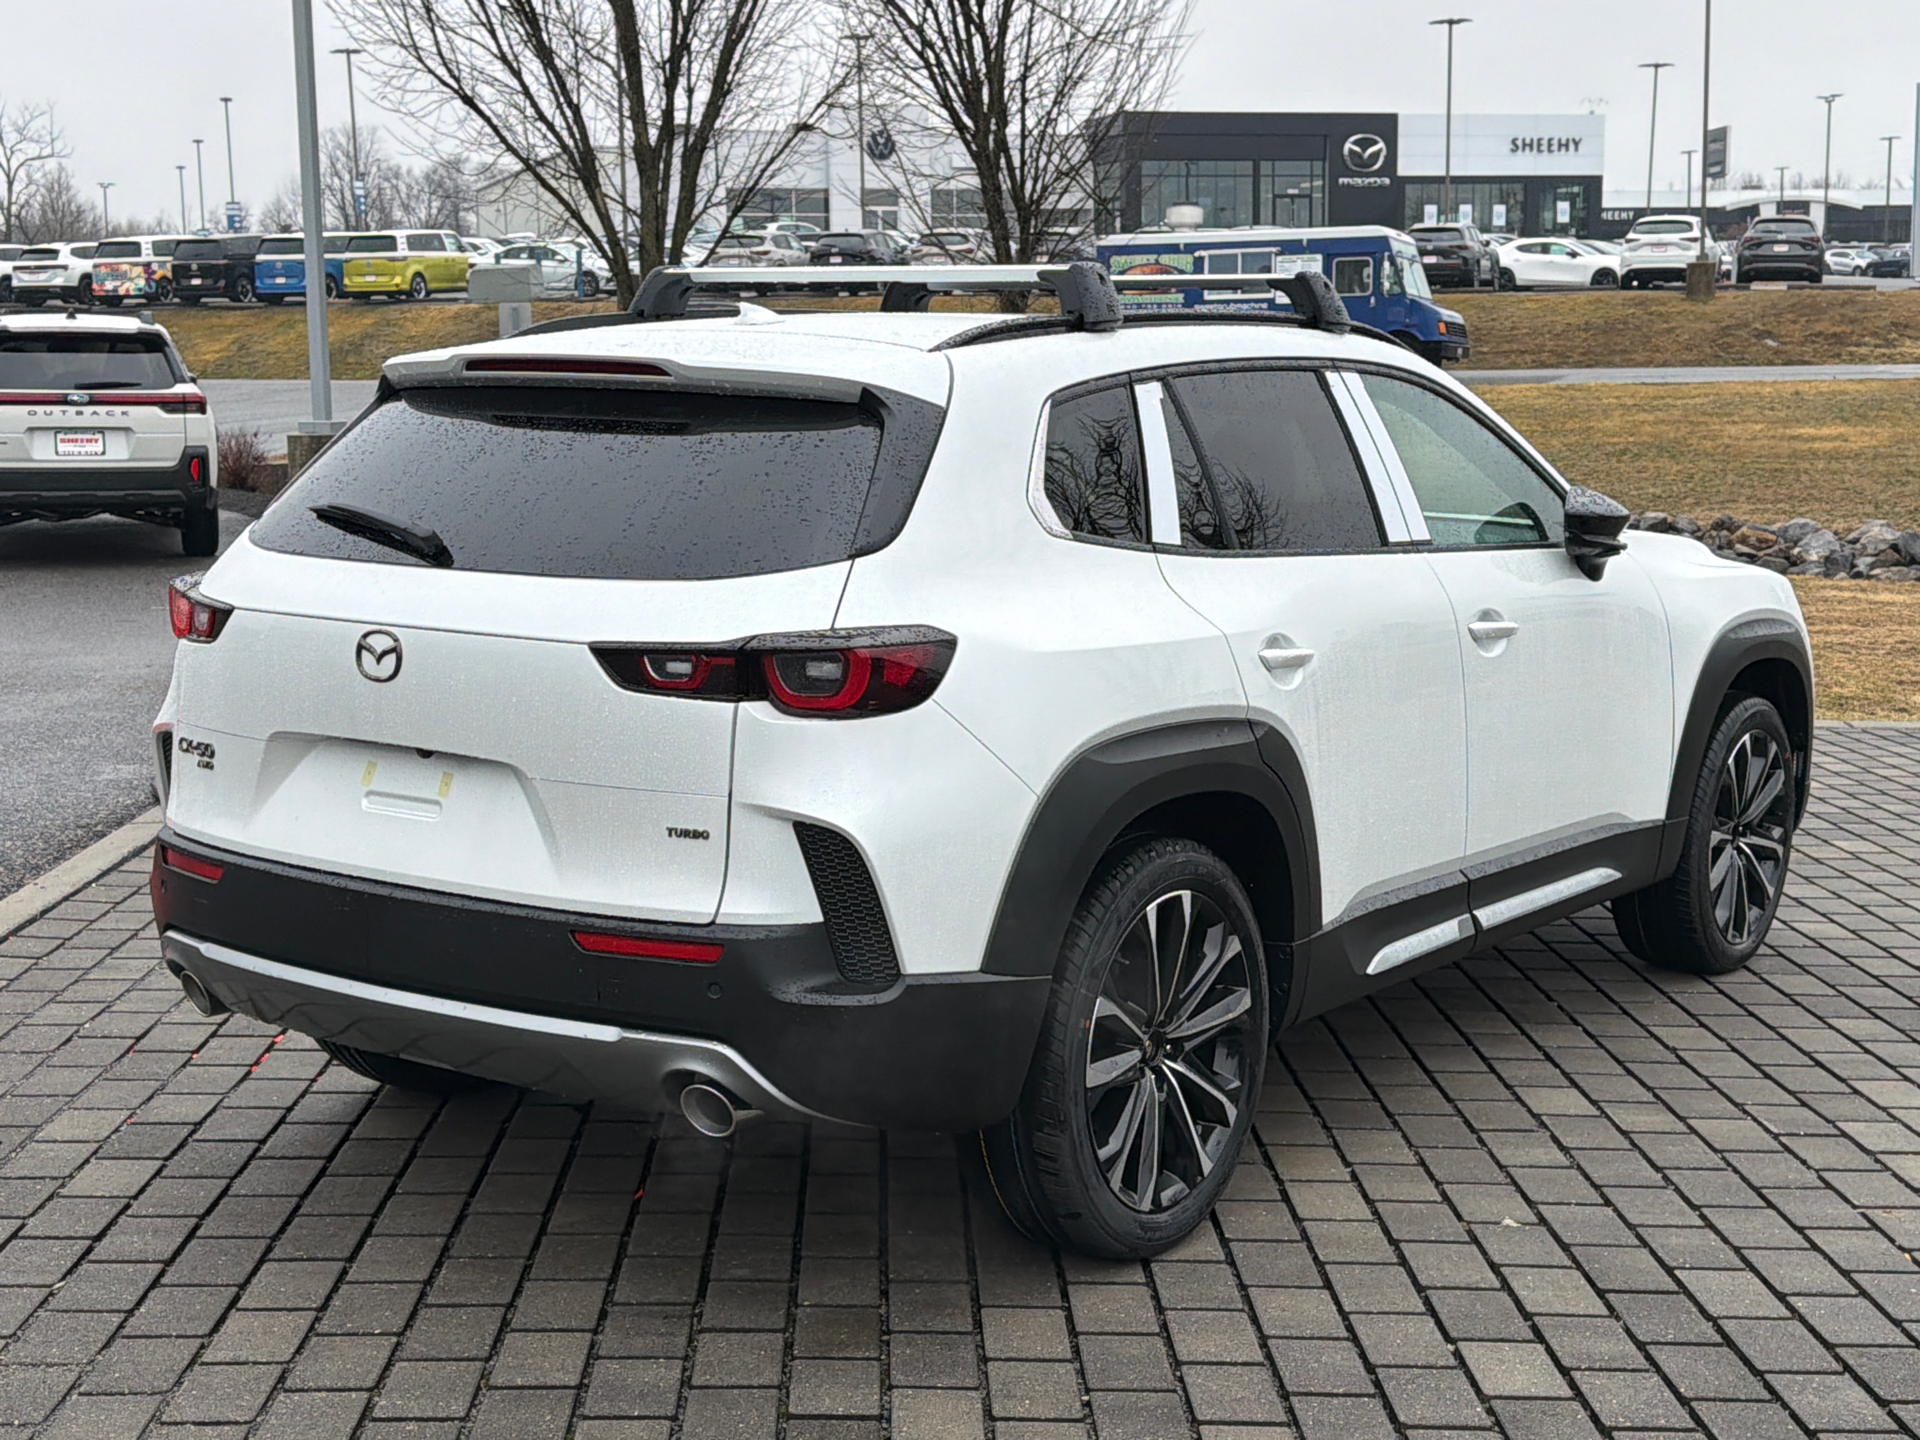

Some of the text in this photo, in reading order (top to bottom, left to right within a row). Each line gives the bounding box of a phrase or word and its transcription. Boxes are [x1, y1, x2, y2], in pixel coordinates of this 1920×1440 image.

[1510, 137, 1582, 153] SHEEHY
[1601, 210, 1635, 220] HEEHY
[178, 737, 215, 759] CX-50
[666, 827, 710, 841] TURBO
